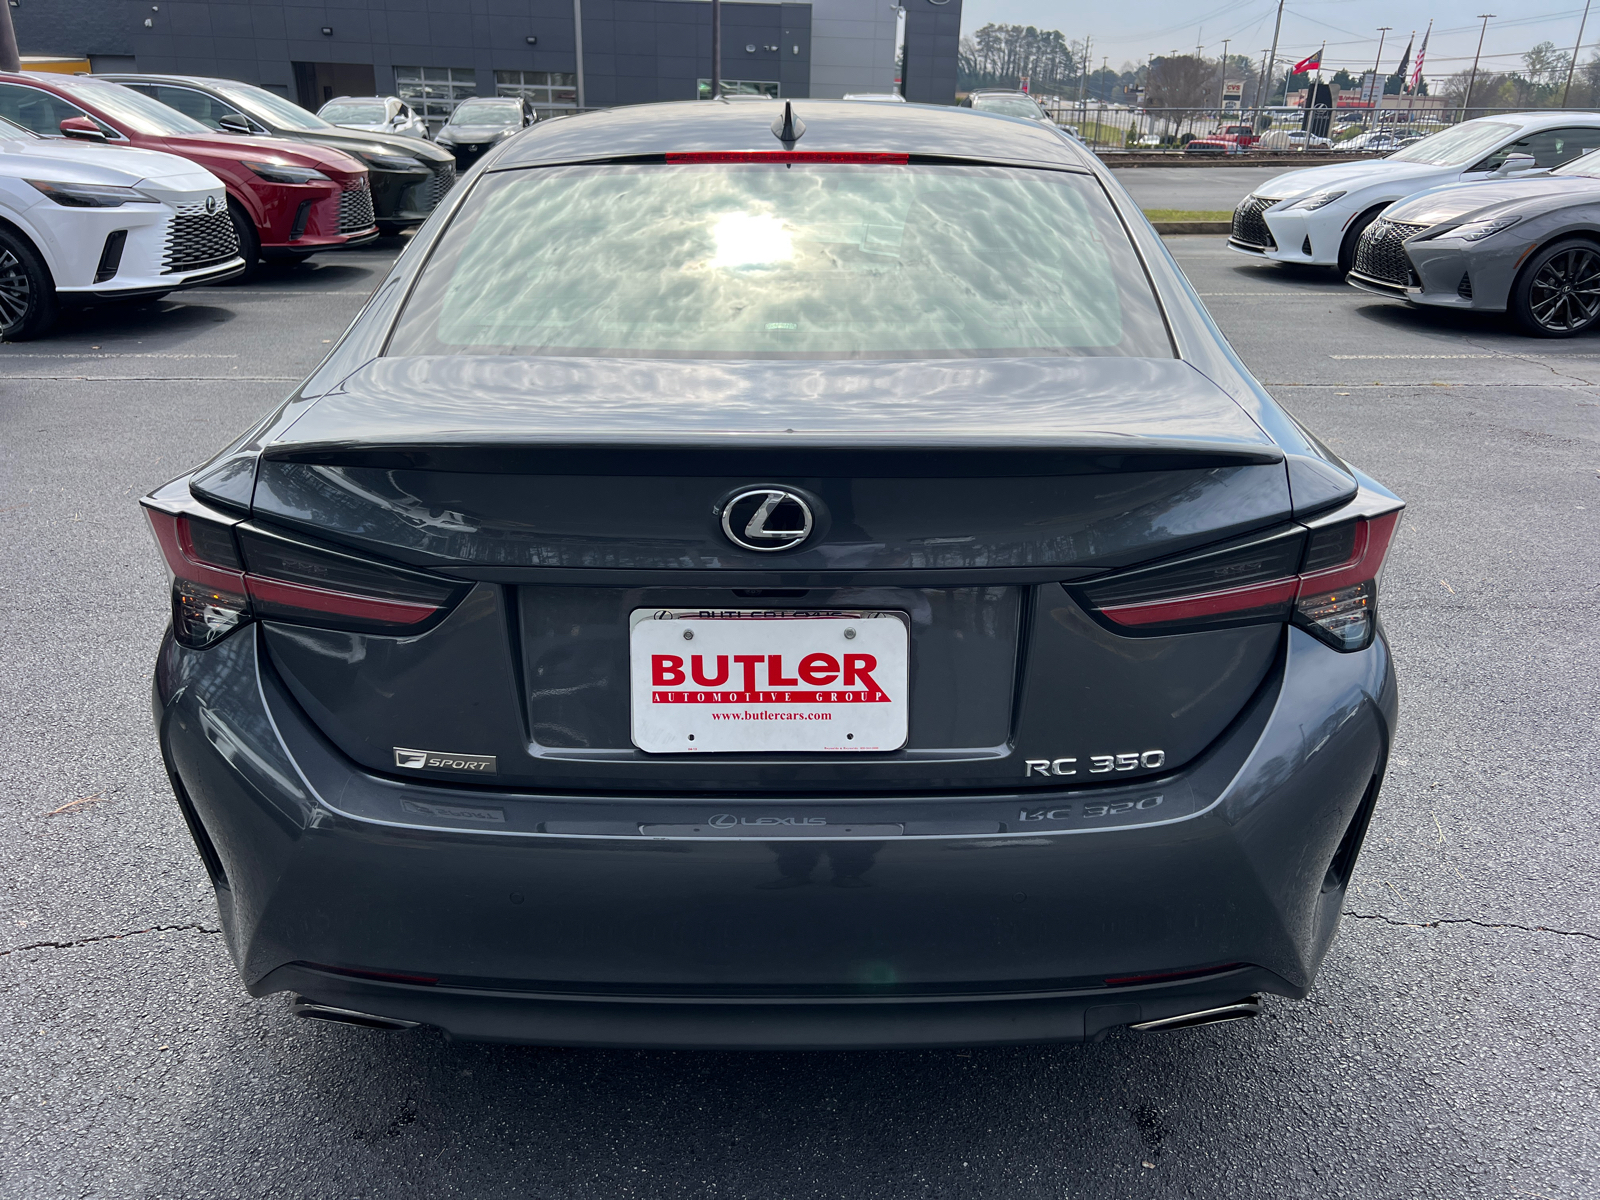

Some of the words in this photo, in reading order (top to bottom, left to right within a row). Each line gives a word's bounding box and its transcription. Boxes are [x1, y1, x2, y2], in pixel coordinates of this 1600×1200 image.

[654, 692, 791, 702] AUTOMOTIVE
[816, 692, 882, 702] GROUP
[712, 711, 832, 721] www.butlercars.com
[428, 758, 490, 770] SPORT
[1025, 758, 1077, 777] RC
[1089, 750, 1165, 773] 350
[741, 817, 827, 826] LEXUS
